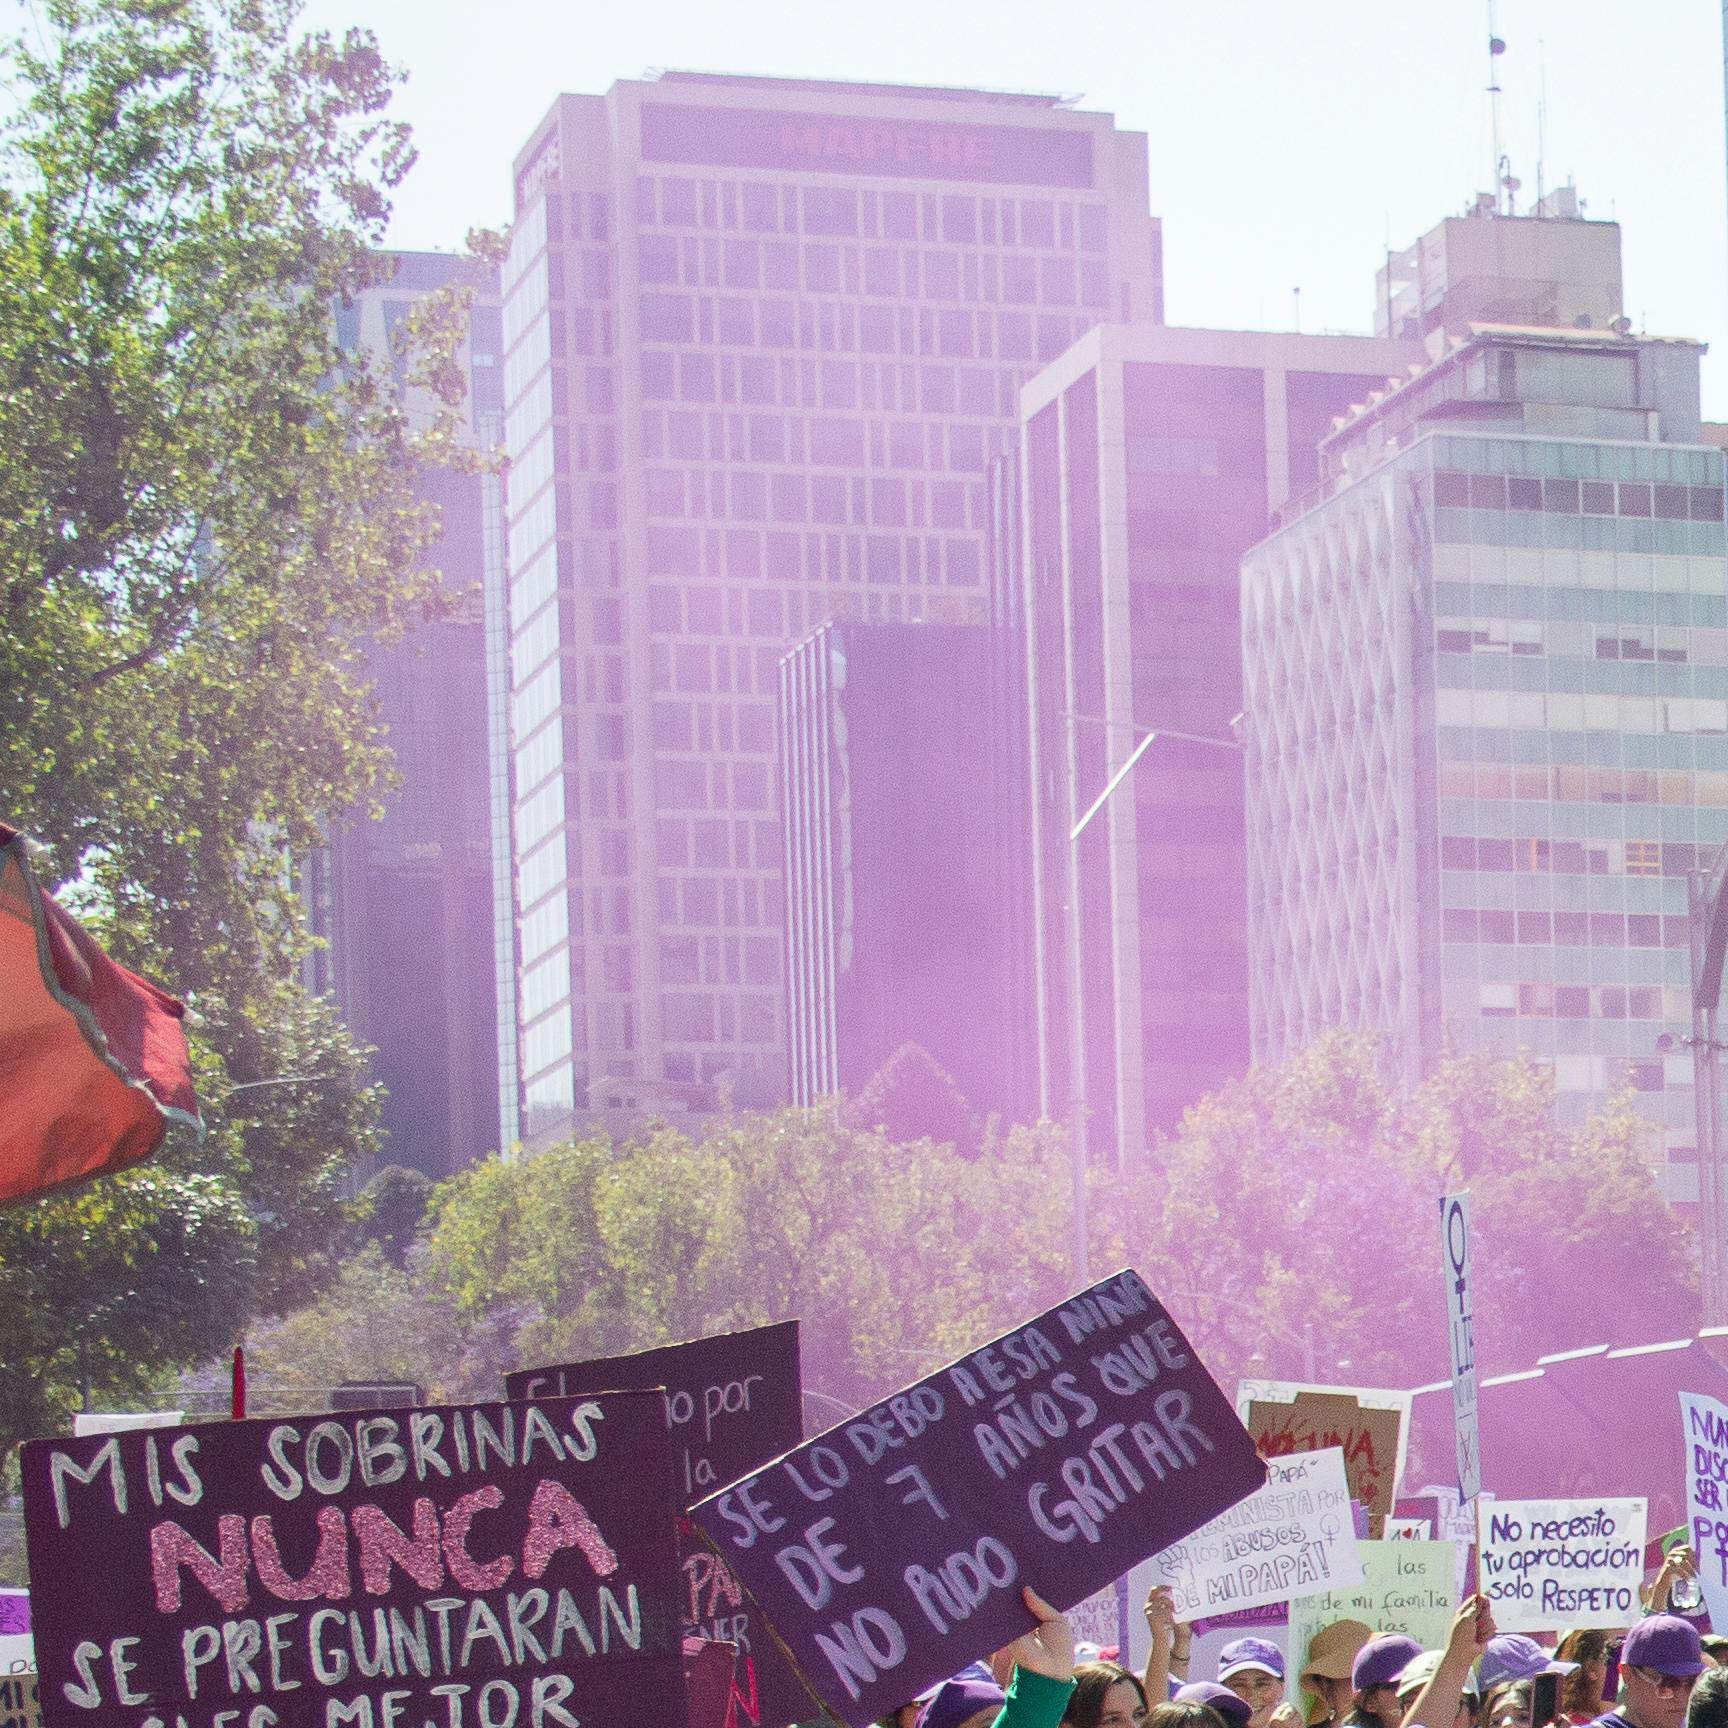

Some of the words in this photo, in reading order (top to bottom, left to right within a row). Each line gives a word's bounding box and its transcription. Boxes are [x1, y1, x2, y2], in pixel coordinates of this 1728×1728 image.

[780, 122, 993, 167] MAPFRE
[704, 1374, 764, 1443] por
[715, 1478, 787, 1549] SE
[782, 1443, 850, 1504] LO
[844, 1382, 948, 1464] DEBO
[972, 1326, 1060, 1391] ESA
[51, 1433, 205, 1529] MIS
[259, 1400, 606, 1502] SOBRINAS
[683, 1448, 718, 1495] la
[774, 1516, 866, 1614] DE
[884, 1461, 952, 1523] 7
[969, 1371, 1101, 1481] AÑOS
[1088, 1316, 1189, 1398] QUE
[1694, 1477, 1725, 1510] SER
[149, 1477, 620, 1615] NUNCA
[812, 1605, 908, 1702] NO
[901, 1535, 1019, 1637] PUDO
[1025, 1388, 1218, 1545] GRITAR
[1222, 1522, 1308, 1562] ABUSOS
[1490, 1511, 1525, 1544] No
[1530, 1508, 1616, 1543] necesito
[1206, 1573, 1238, 1606] MI
[1237, 1539, 1332, 1598] PAPÁ!
[1397, 1554, 1427, 1574] las
[1482, 1550, 1506, 1574] tu
[1509, 1539, 1641, 1578] aprobación
[1320, 1592, 1342, 1610] de
[1351, 1592, 1373, 1608] mi
[1383, 1590, 1449, 1617] familia
[1490, 1578, 1534, 1600] solo
[62, 1639, 150, 1709] SE
[180, 1583, 643, 1700] PREGUNTARAN
[1378, 1614, 1408, 1633] las
